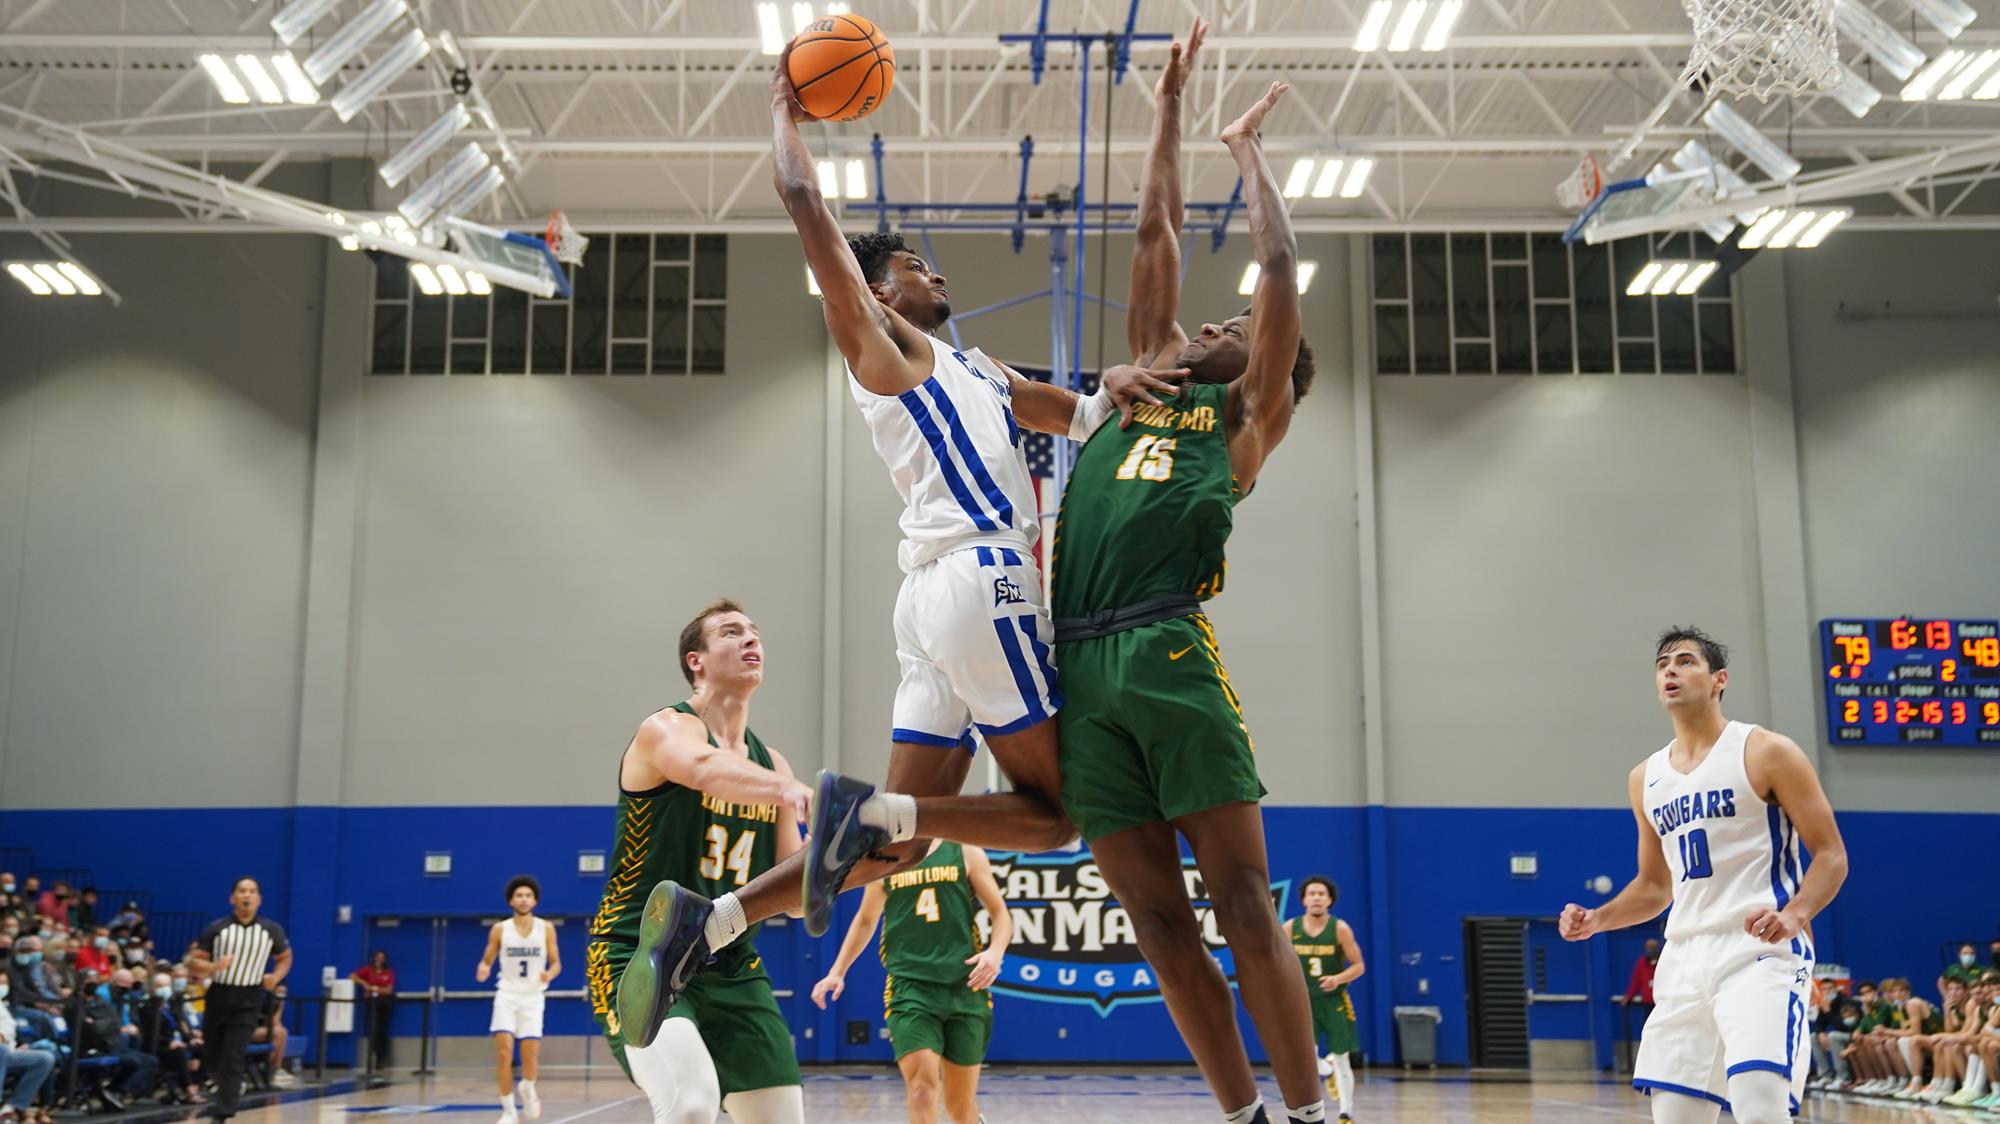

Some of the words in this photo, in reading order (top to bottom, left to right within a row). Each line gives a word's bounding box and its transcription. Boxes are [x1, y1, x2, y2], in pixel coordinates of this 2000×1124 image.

[1176, 406, 1217, 432] MA
[1115, 434, 1177, 482] 15
[1835, 636, 1871, 666] 79
[1963, 638, 2000, 667] 48
[1941, 659, 1957, 682] 2
[1844, 700, 1860, 723] 2
[1873, 700, 1888, 724] 3
[1951, 702, 1966, 725] 3
[1984, 702, 2000, 725] 9
[1653, 788, 1736, 836] COUGARS
[699, 823, 756, 886] 34
[1679, 828, 1713, 882] 10
[889, 869, 925, 890] POINT
[925, 865, 959, 884] LOMA
[915, 887, 940, 922] 4
[974, 907, 1047, 944] AN
[519, 960, 529, 978] 3
[1308, 957, 1323, 977] 3
